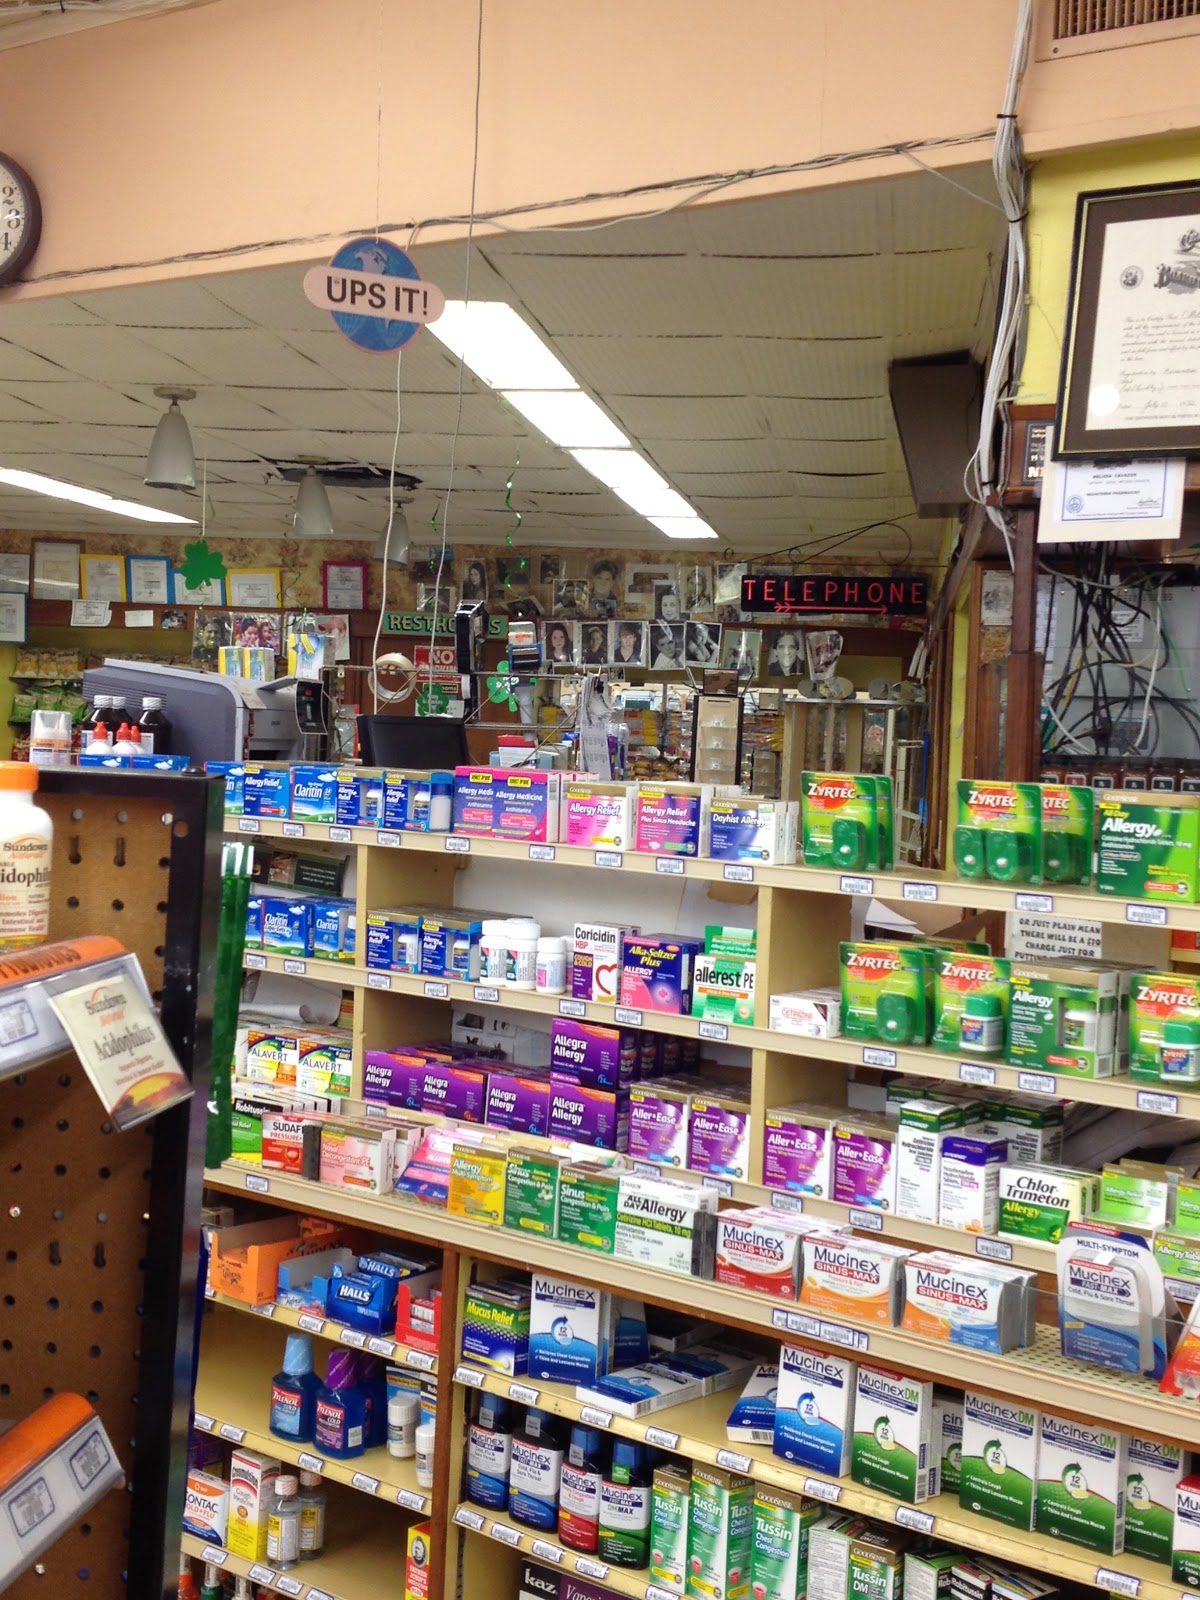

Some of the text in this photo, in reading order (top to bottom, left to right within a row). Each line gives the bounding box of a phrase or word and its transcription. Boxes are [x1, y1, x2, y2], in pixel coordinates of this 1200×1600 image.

[2, 186, 15, 205] 2
[327, 275, 428, 315] UPS IT!
[743, 579, 924, 604] TELEPHONE
[428, 650, 454, 665] NO
[244, 777, 263, 788] Allergy
[294, 784, 322, 798] Claritin
[458, 787, 477, 796] Allergy
[495, 791, 543, 802] Allergy Medicine
[807, 782, 856, 800] ZYRTEC
[967, 790, 1017, 808] ZYRTEC
[1042, 793, 1070, 810] RTEC
[569, 803, 620, 817] Allergy Relief
[641, 806, 688, 817] Allergy Relief
[652, 817, 696, 827] Sinus Headache
[712, 813, 769, 828] Dayhist Allergy
[1101, 817, 1157, 838] Allergy
[3, 841, 48, 852] Sundown
[265, 913, 288, 927] Claritin
[316, 919, 338, 931] Claritin
[1019, 918, 1101, 934] OR JUST PLAIN MEAN
[368, 930, 387, 939] Allergy
[574, 926, 616, 944] Coricidin
[1020, 930, 1045, 939] THERE
[1047, 933, 1066, 942] WILL
[1068, 935, 1077, 943] BE
[575, 940, 589, 950] HBP
[629, 945, 677, 961] Alka-Seltzer
[1025, 941, 1095, 957] CHARGE JUST FOR
[640, 956, 660, 968] Plus
[846, 952, 900, 971] ZYRTEC
[624, 965, 654, 976] ALLERGY
[695, 966, 754, 989] allerest PE
[940, 961, 994, 982] ZYRTEC
[85, 993, 128, 1015] Sundown
[1012, 990, 1054, 1007] Allergy
[1136, 985, 1197, 1007] ZYRTEC
[94, 1023, 156, 1061] Acidophilus
[554, 1034, 587, 1050] Allegra
[251, 1047, 289, 1062] ALAVERT
[553, 1046, 585, 1064] Allergy
[302, 1057, 343, 1073] ALAVERT
[366, 1064, 393, 1077] Allegra
[365, 1074, 391, 1088] Allergy
[424, 1075, 449, 1088] Allegra
[423, 1085, 447, 1099] Allergy
[490, 1087, 517, 1102] Allegra
[489, 1098, 515, 1113] Allergy
[552, 1096, 585, 1113] Allegra
[551, 1108, 583, 1125] Allergy
[272, 1121, 303, 1133] SUDAF
[322, 1149, 360, 1164] Decongestant
[453, 1159, 483, 1174] Allergy
[508, 1163, 532, 1178] Sinus
[508, 1175, 535, 1187] Congestion
[1016, 1176, 1059, 1194] Chlor-
[561, 1184, 586, 1199] Sinus
[627, 1195, 642, 1204] ALL
[1007, 1184, 1070, 1208] Trimeton
[560, 1195, 591, 1208] Congestion
[623, 1201, 642, 1210] DAY
[641, 1198, 687, 1223] Allergy
[1002, 1201, 1040, 1219] Allergy
[616, 1212, 642, 1225] Cetirizine
[723, 1225, 784, 1252] Mucinex
[1051, 1228, 1061, 1239] 4
[1076, 1239, 1139, 1258] MULTI-SYMPTOM
[1157, 1246, 1184, 1258] Allergy
[814, 1246, 880, 1274] Mucinex
[367, 1263, 395, 1277] HALLS
[1069, 1265, 1131, 1289] Mucinex
[535, 1280, 595, 1301] Mucinex
[916, 1270, 988, 1299] Mucinex
[339, 1285, 371, 1302] HALLS
[1083, 1290, 1094, 1298] Flu
[1100, 1293, 1114, 1303] Sore
[1115, 1297, 1135, 1307] Throat
[466, 1301, 515, 1326] Mucus Relief
[783, 1348, 844, 1380] Mucinex
[272, 1390, 299, 1406] TYLENOL
[317, 1402, 342, 1419] TYLENOL
[470, 1428, 504, 1446] Mucinex
[512, 1444, 551, 1465] Mucinex
[562, 1468, 597, 1488] Mucinex
[1071, 1475, 1080, 1484] 12
[602, 1486, 643, 1501] Mucinex
[654, 1496, 682, 1516] Tussin
[654, 1508, 668, 1518] Chest
[693, 1493, 723, 1518] Tussin
[693, 1507, 707, 1519] Chest
[1047, 1499, 1082, 1515] Controls Cough
[654, 1515, 682, 1530] Congestion
[693, 1514, 721, 1534] Congestion
[1047, 1507, 1059, 1516] Thins
[1070, 1513, 1090, 1525] Loosens
[1090, 1519, 1106, 1531] Mucus
[756, 1517, 793, 1542] Tussin
[756, 1531, 773, 1544] Chest
[755, 1540, 790, 1559] Congestion
[525, 1568, 556, 1594] kaz
[852, 1567, 887, 1587] Tussin
[853, 1580, 868, 1594] DM
[952, 1577, 985, 1600] Robitussin
